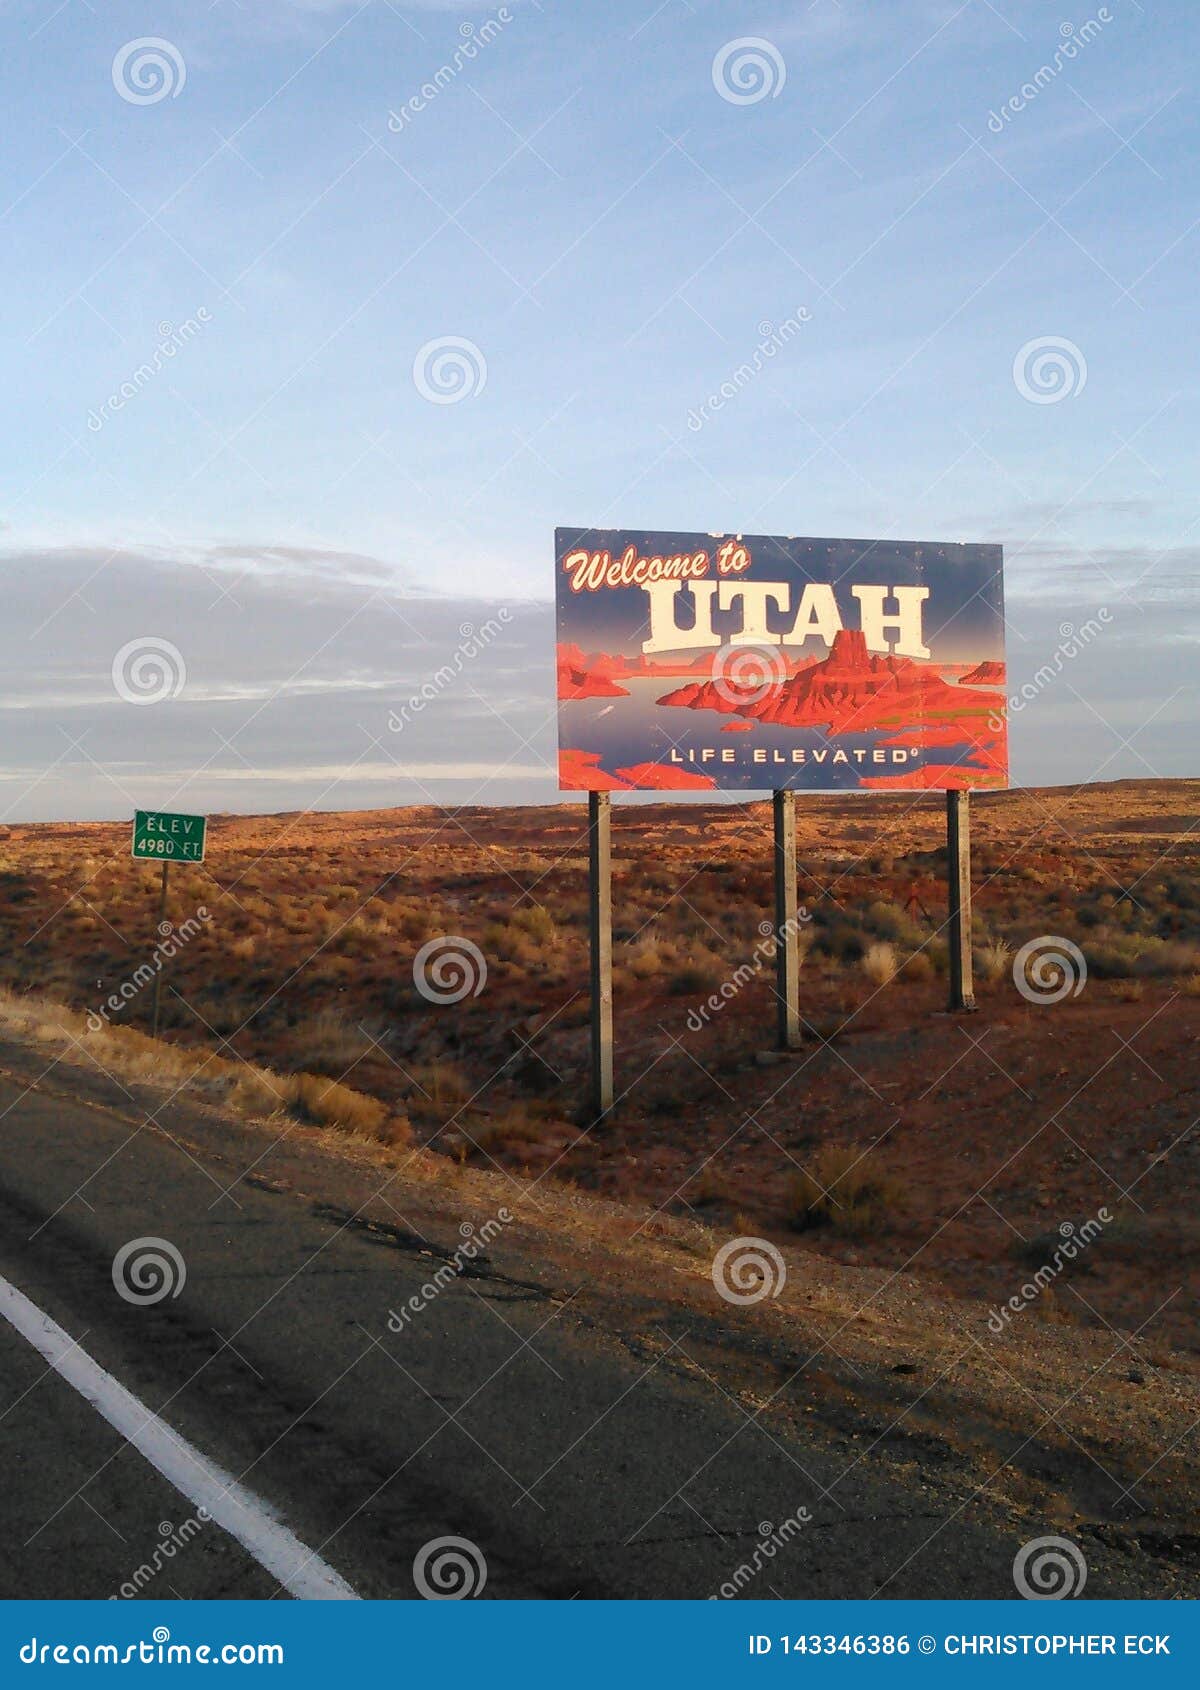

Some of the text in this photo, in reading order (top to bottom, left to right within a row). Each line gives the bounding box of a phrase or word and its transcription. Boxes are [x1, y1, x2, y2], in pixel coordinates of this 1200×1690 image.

[566, 541, 749, 591] Welcome to
[641, 578, 931, 659] UTAH
[671, 749, 735, 763] LIFE
[147, 817, 193, 834] ELEV
[138, 838, 174, 854] 4980
